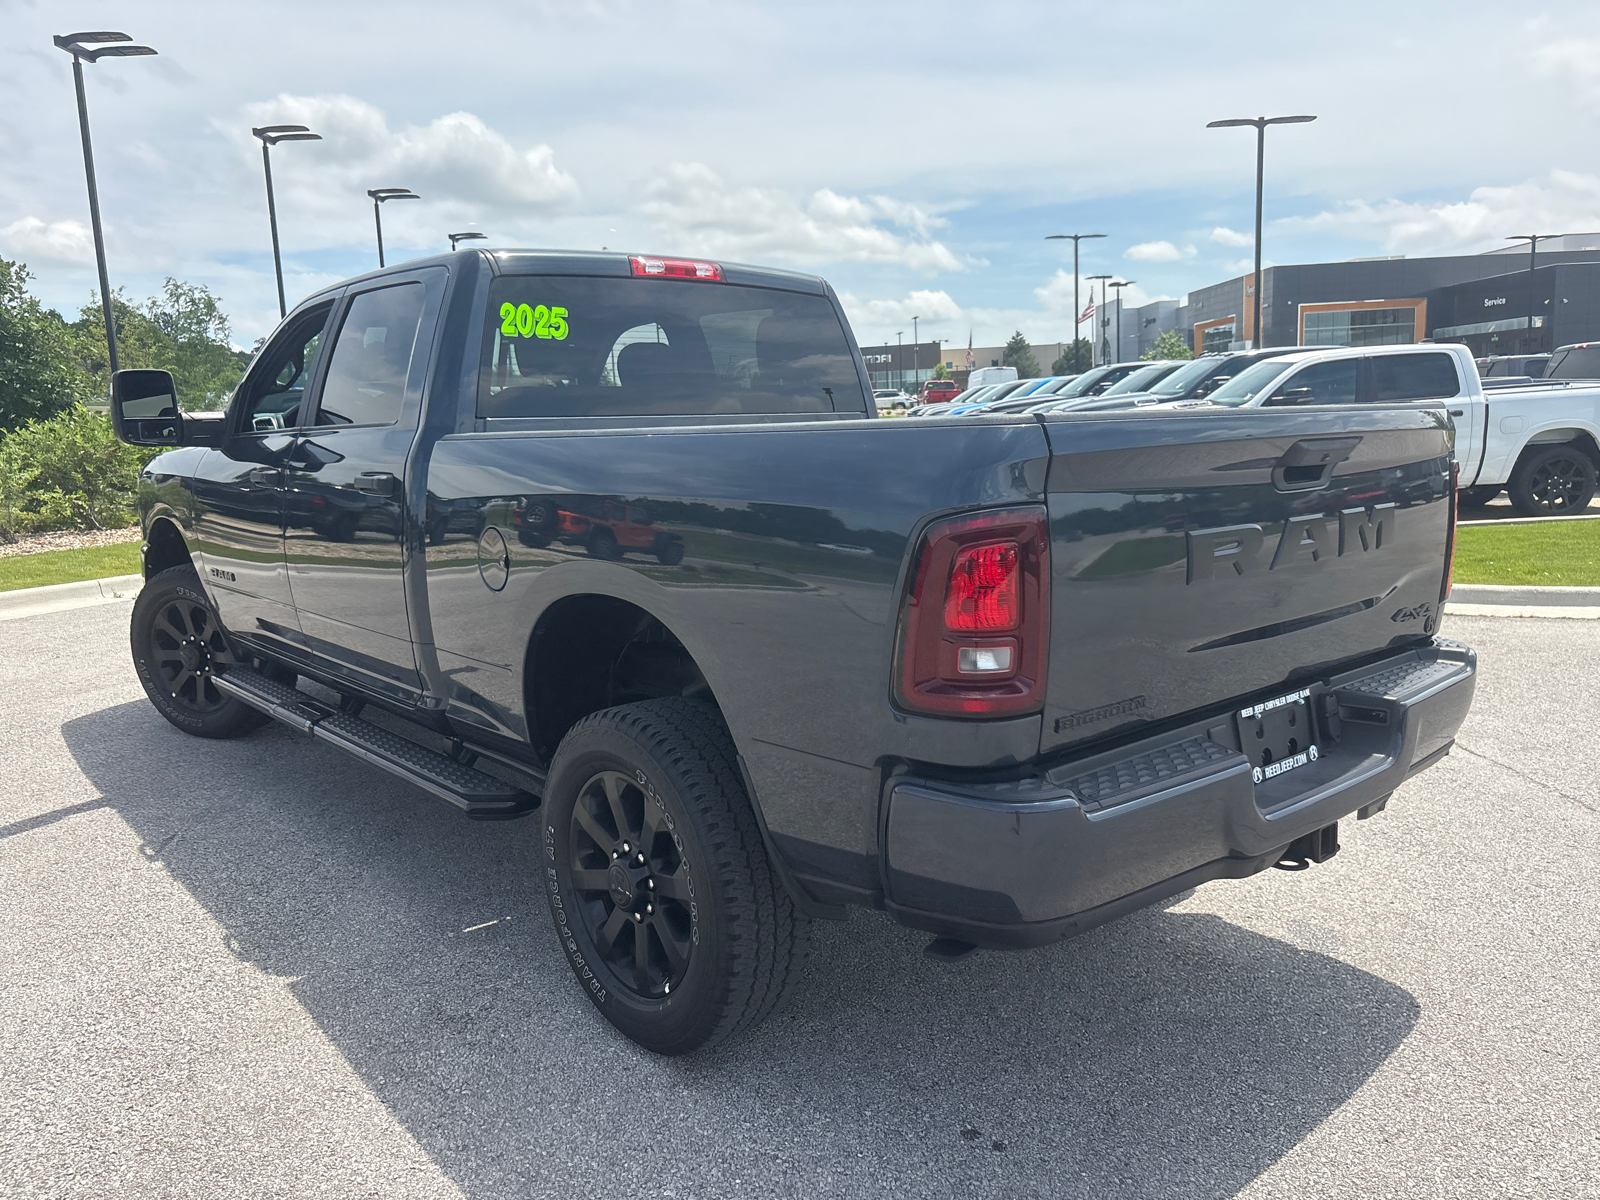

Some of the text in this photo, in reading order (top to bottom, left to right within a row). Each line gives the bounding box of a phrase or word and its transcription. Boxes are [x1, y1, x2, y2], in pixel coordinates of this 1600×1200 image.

[1484, 297, 1506, 307] Service
[500, 302, 569, 340] 2025
[1185, 502, 1396, 585] RAM
[1241, 707, 1254, 718] REED
[1254, 703, 1265, 714] JEEP
[1265, 697, 1286, 711] CHRYSLER
[1286, 691, 1300, 703] DODGE
[1265, 753, 1307, 778] REEDJEEP.COM
[547, 867, 607, 1003] TRANSFORCE
